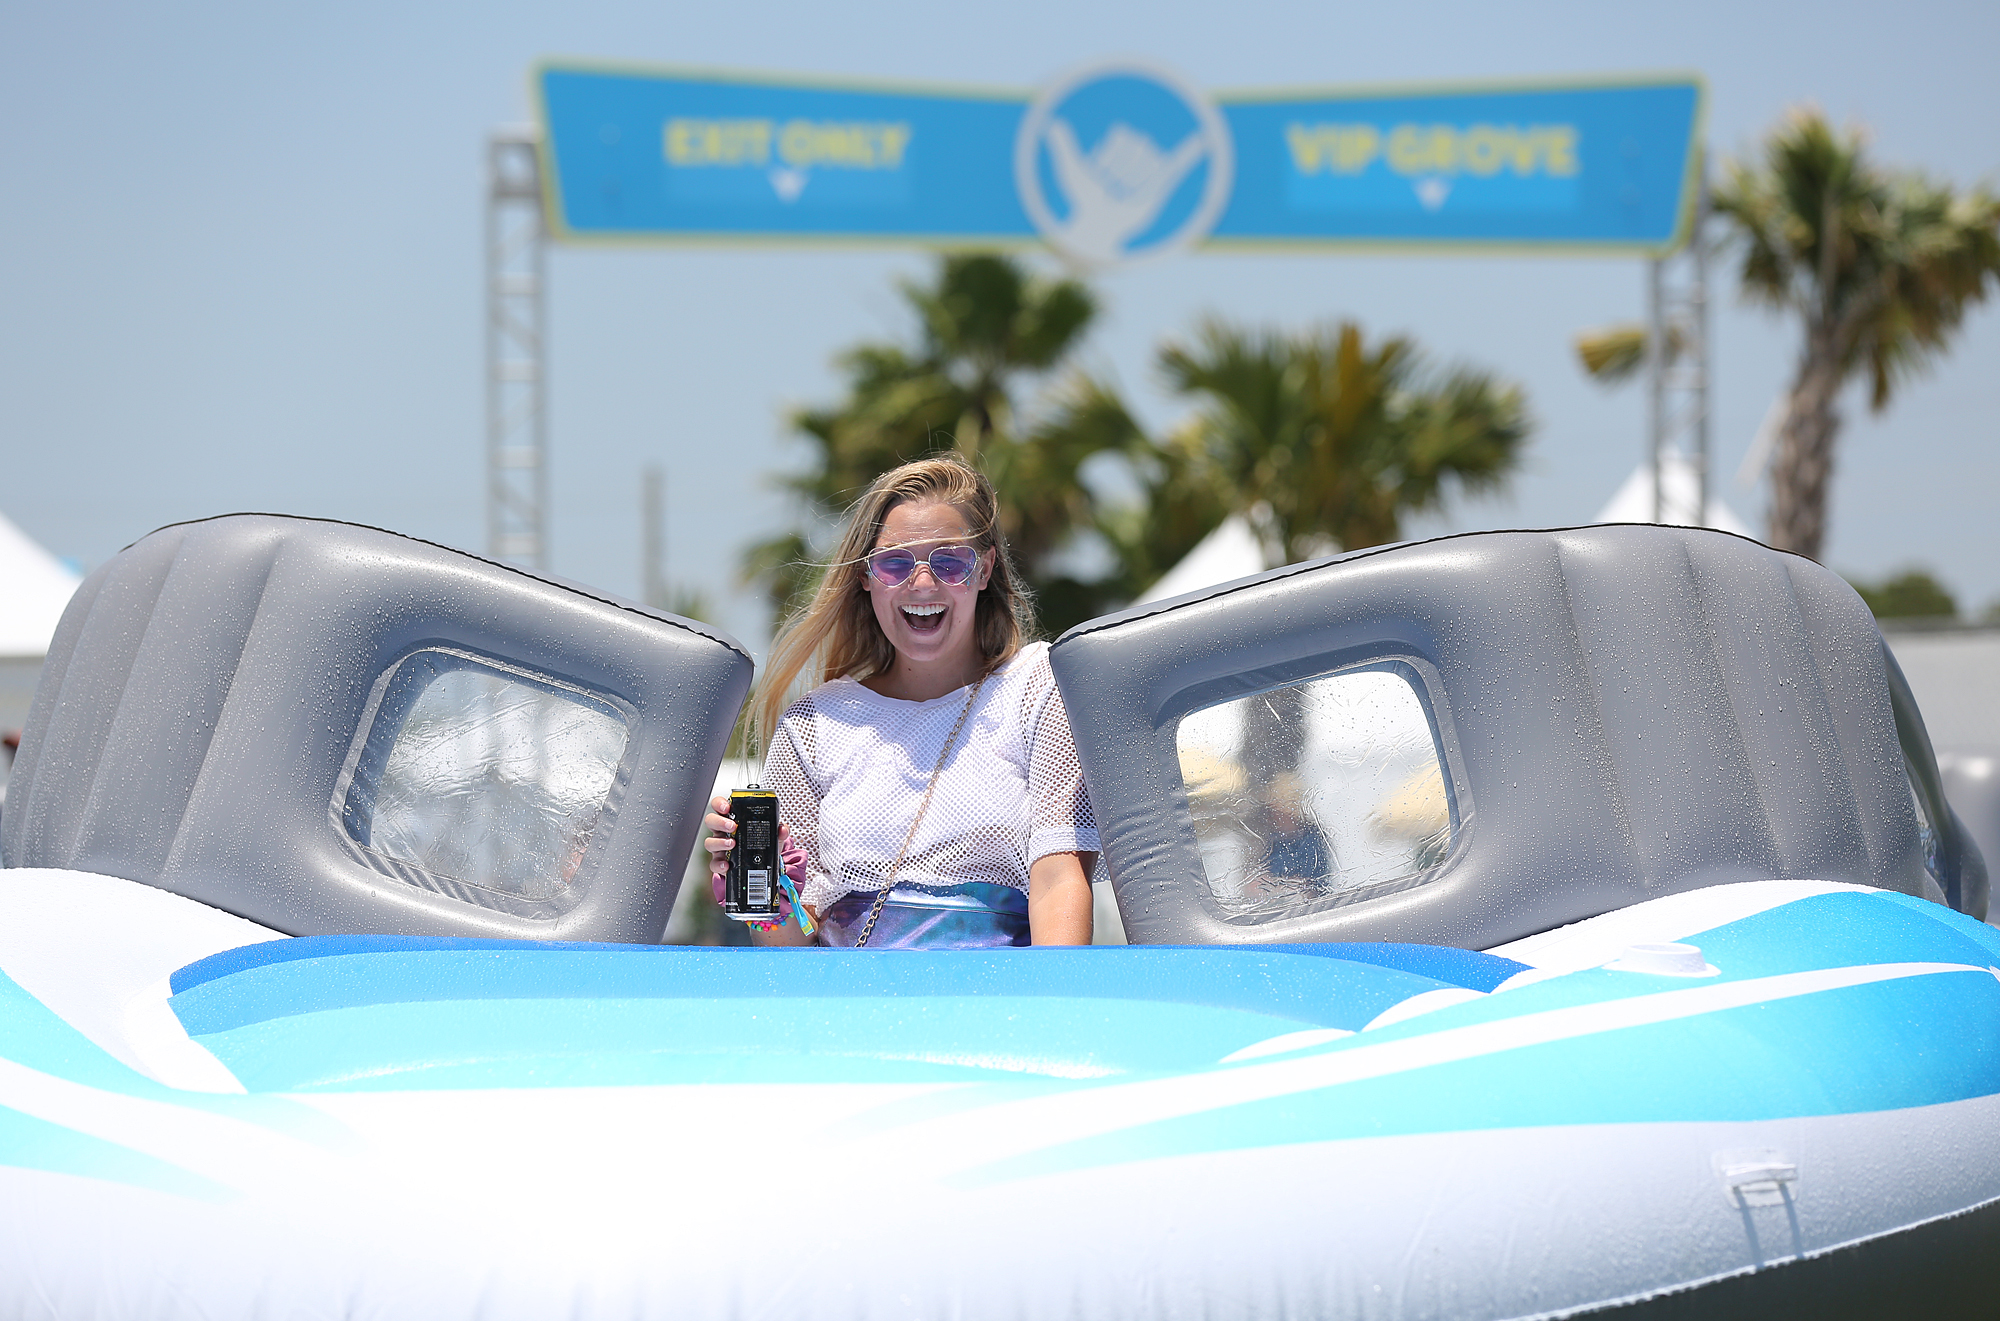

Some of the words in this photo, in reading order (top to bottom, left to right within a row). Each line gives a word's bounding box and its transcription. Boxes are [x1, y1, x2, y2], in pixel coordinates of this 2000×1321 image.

[664, 118, 772, 168] EXIT
[778, 119, 911, 170] ONLY
[1286, 123, 1379, 176] VIP
[1387, 123, 1580, 177] GROVE
